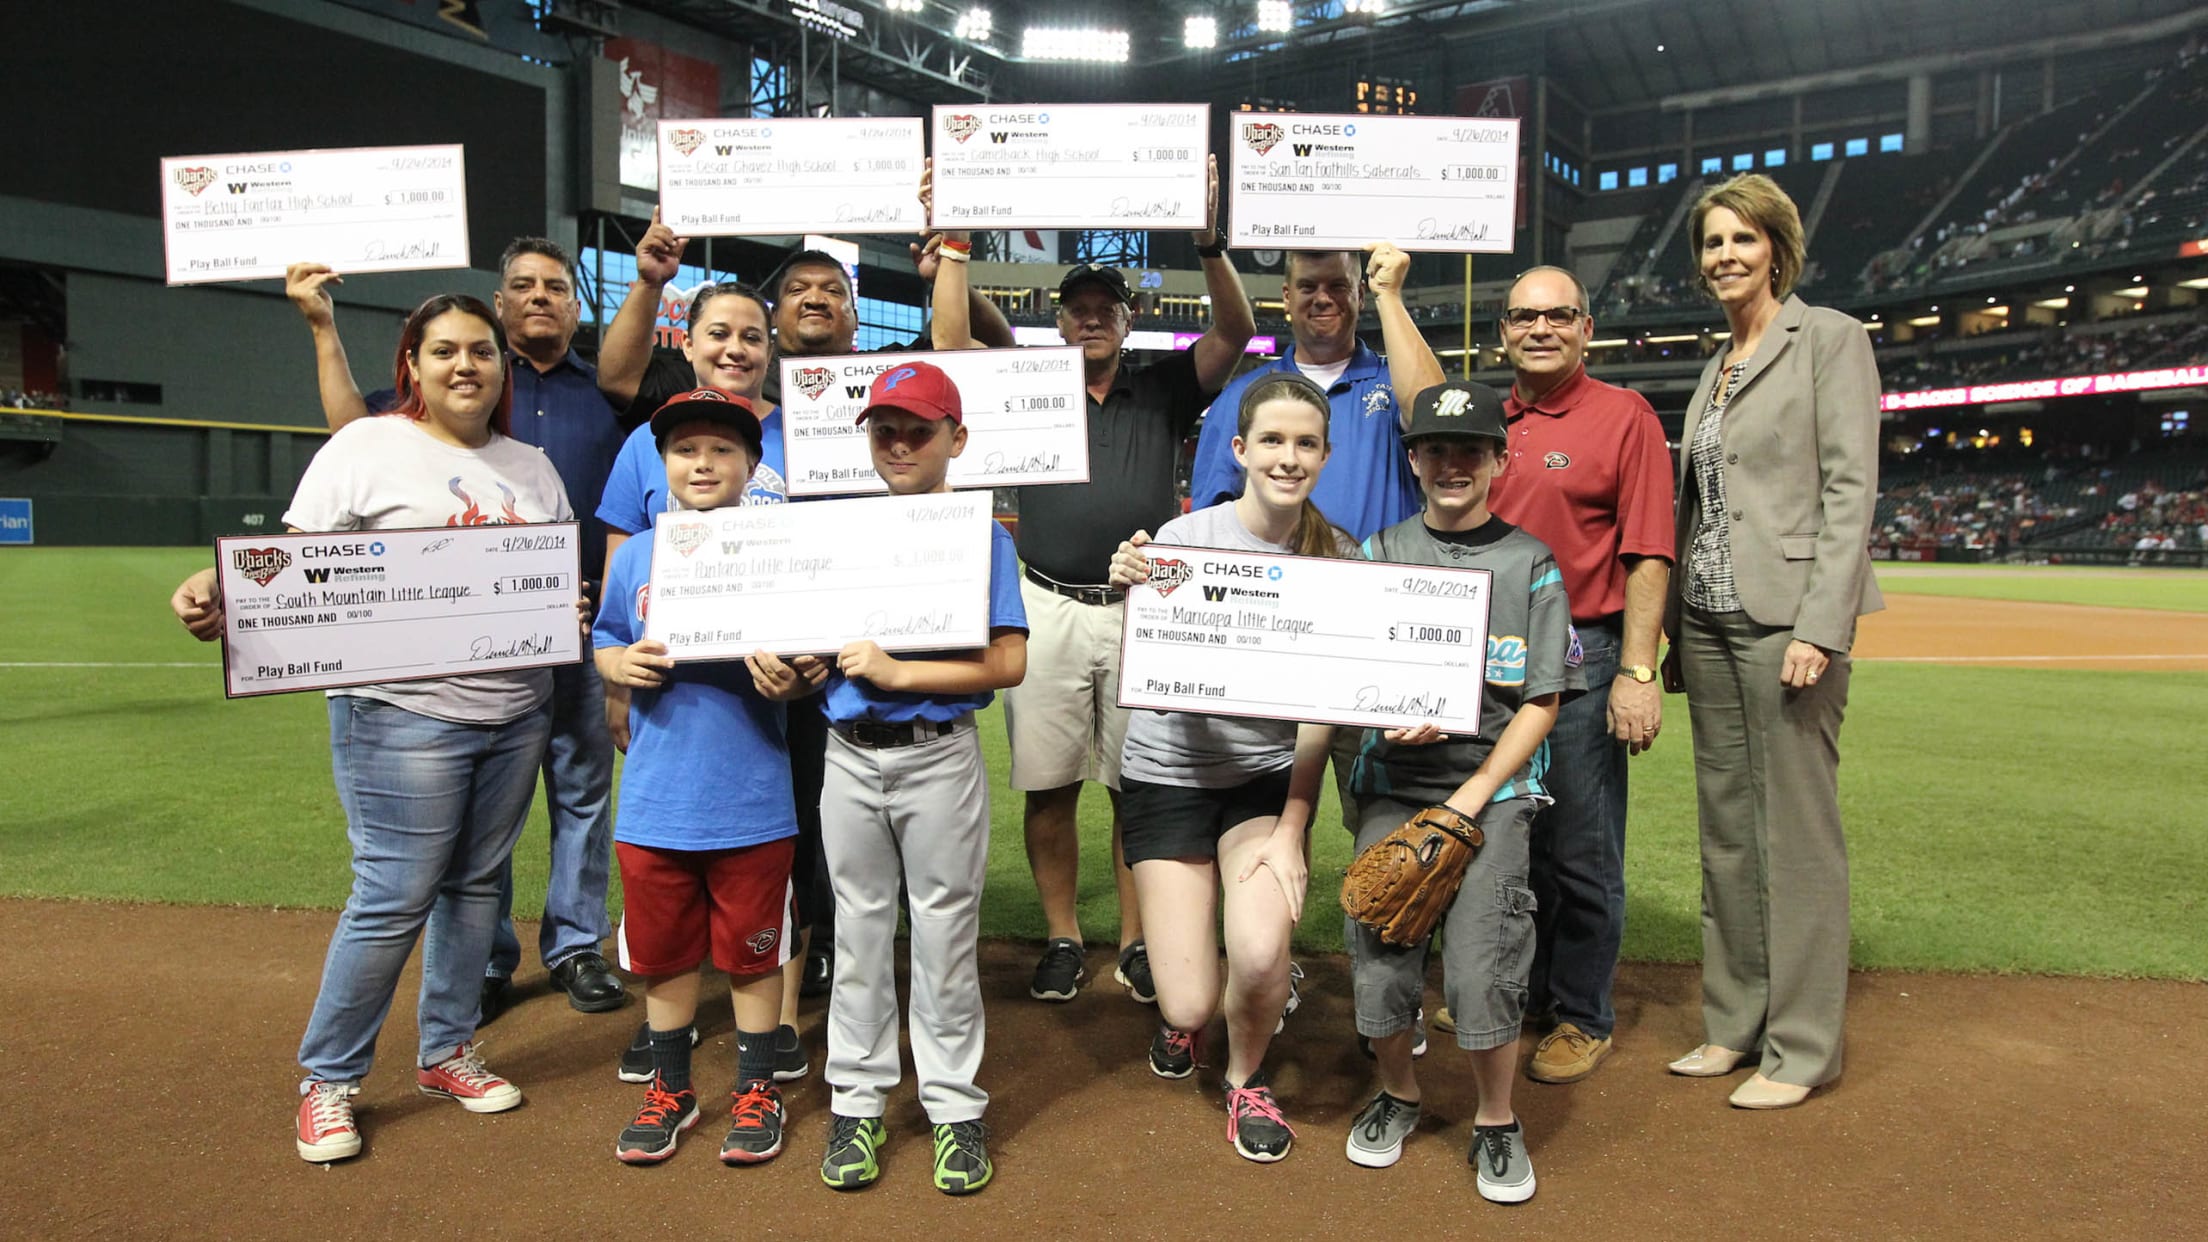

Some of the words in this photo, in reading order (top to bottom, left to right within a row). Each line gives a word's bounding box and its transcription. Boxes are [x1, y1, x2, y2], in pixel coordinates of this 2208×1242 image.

[990, 114, 1035, 124] CHASE
[714, 128, 757, 138] CHASE
[1292, 124, 1340, 135] CHASE
[1453, 129, 1508, 142] 9/26/2014
[1036, 148, 1060, 164] High
[1064, 147, 1099, 160] School
[1133, 151, 1138, 161] $
[1148, 150, 1188, 160] 1,000.00
[226, 163, 276, 174] CHASE
[777, 160, 801, 177] High
[804, 159, 836, 171] School
[854, 162, 859, 172] $
[867, 160, 906, 171] 1,000.00
[942, 168, 955, 176] ONE
[958, 167, 994, 176] THOUSAND
[997, 167, 1010, 175] AND
[1270, 161, 1290, 177] San
[1294, 160, 1312, 177] Tan
[1316, 160, 1359, 178] Foothills
[1442, 169, 1447, 180] $
[1457, 167, 1498, 180] 1,000.00
[685, 178, 721, 186] THOUSAND
[1241, 182, 1255, 191] ONE
[1258, 182, 1297, 192] THOUSAND
[1300, 184, 1314, 192] AND
[289, 196, 314, 213] High
[317, 194, 353, 207] School
[385, 195, 391, 205] $
[401, 191, 444, 203] 1,000.00
[952, 206, 970, 217] Play
[973, 206, 989, 215] Ball
[991, 206, 1011, 215] Fund
[176, 221, 190, 230] ONE
[194, 219, 235, 228] THOUSAND
[682, 215, 699, 225] Play
[702, 214, 718, 223] Ball
[721, 214, 740, 223] Fund
[1252, 224, 1271, 236] Play
[1274, 224, 1290, 235] Ball
[1294, 224, 1314, 236] Fund
[190, 259, 211, 271] Play
[214, 258, 231, 267] Ball
[234, 256, 256, 266] Fund
[1139, 271, 1162, 288] 20
[1886, 388, 1966, 409] D-BACKS
[1970, 381, 2057, 402] SCIENCE
[2061, 377, 2092, 395] OF
[1005, 401, 1011, 412] $
[1021, 397, 1065, 409] 1,000.00
[794, 428, 809, 437] ONE
[812, 425, 853, 436] THOUSAND
[809, 470, 829, 481] Play
[833, 468, 849, 479] Ball
[853, 467, 876, 478] Fund
[722, 518, 776, 531] CHASE
[502, 535, 566, 552] 9/26/2014
[302, 544, 366, 558] CHASE
[334, 566, 384, 575] Western
[751, 557, 784, 575] Little
[789, 556, 832, 580] League
[1203, 562, 1263, 578] CHASE
[334, 574, 385, 583] Refining
[494, 582, 500, 595] $
[512, 576, 559, 592] 1,000.00
[660, 586, 677, 597] ONE
[680, 584, 723, 596] THOUSAND
[726, 583, 743, 593] AND
[1230, 587, 1279, 599] Western
[1402, 577, 1477, 600] 9/26/2014
[276, 592, 317, 609] South
[322, 588, 386, 607] Mountain
[391, 586, 424, 602] Little
[429, 585, 471, 604] League
[238, 618, 258, 629] ONE
[262, 614, 314, 628] THOUSAND
[317, 612, 337, 624] AND
[347, 609, 372, 619] 00/100
[1172, 606, 1231, 632] Maricopa
[1237, 610, 1267, 629] Little
[1272, 614, 1314, 641] League
[670, 632, 691, 645] Play
[694, 631, 713, 642] Ball
[717, 629, 742, 641] Fund
[1136, 627, 1154, 639] ONE
[1158, 629, 1206, 643] THOUSAND
[1208, 633, 1227, 645] AND
[1237, 635, 1261, 645] 00/100
[1388, 628, 1396, 642] $
[1409, 626, 1461, 644] 1,000.00
[258, 664, 284, 679] Play
[288, 661, 310, 676] Ball
[314, 659, 342, 673] Fund
[1147, 678, 1170, 696] Play
[1174, 680, 1195, 695] Ball
[1199, 682, 1226, 697] Fund
